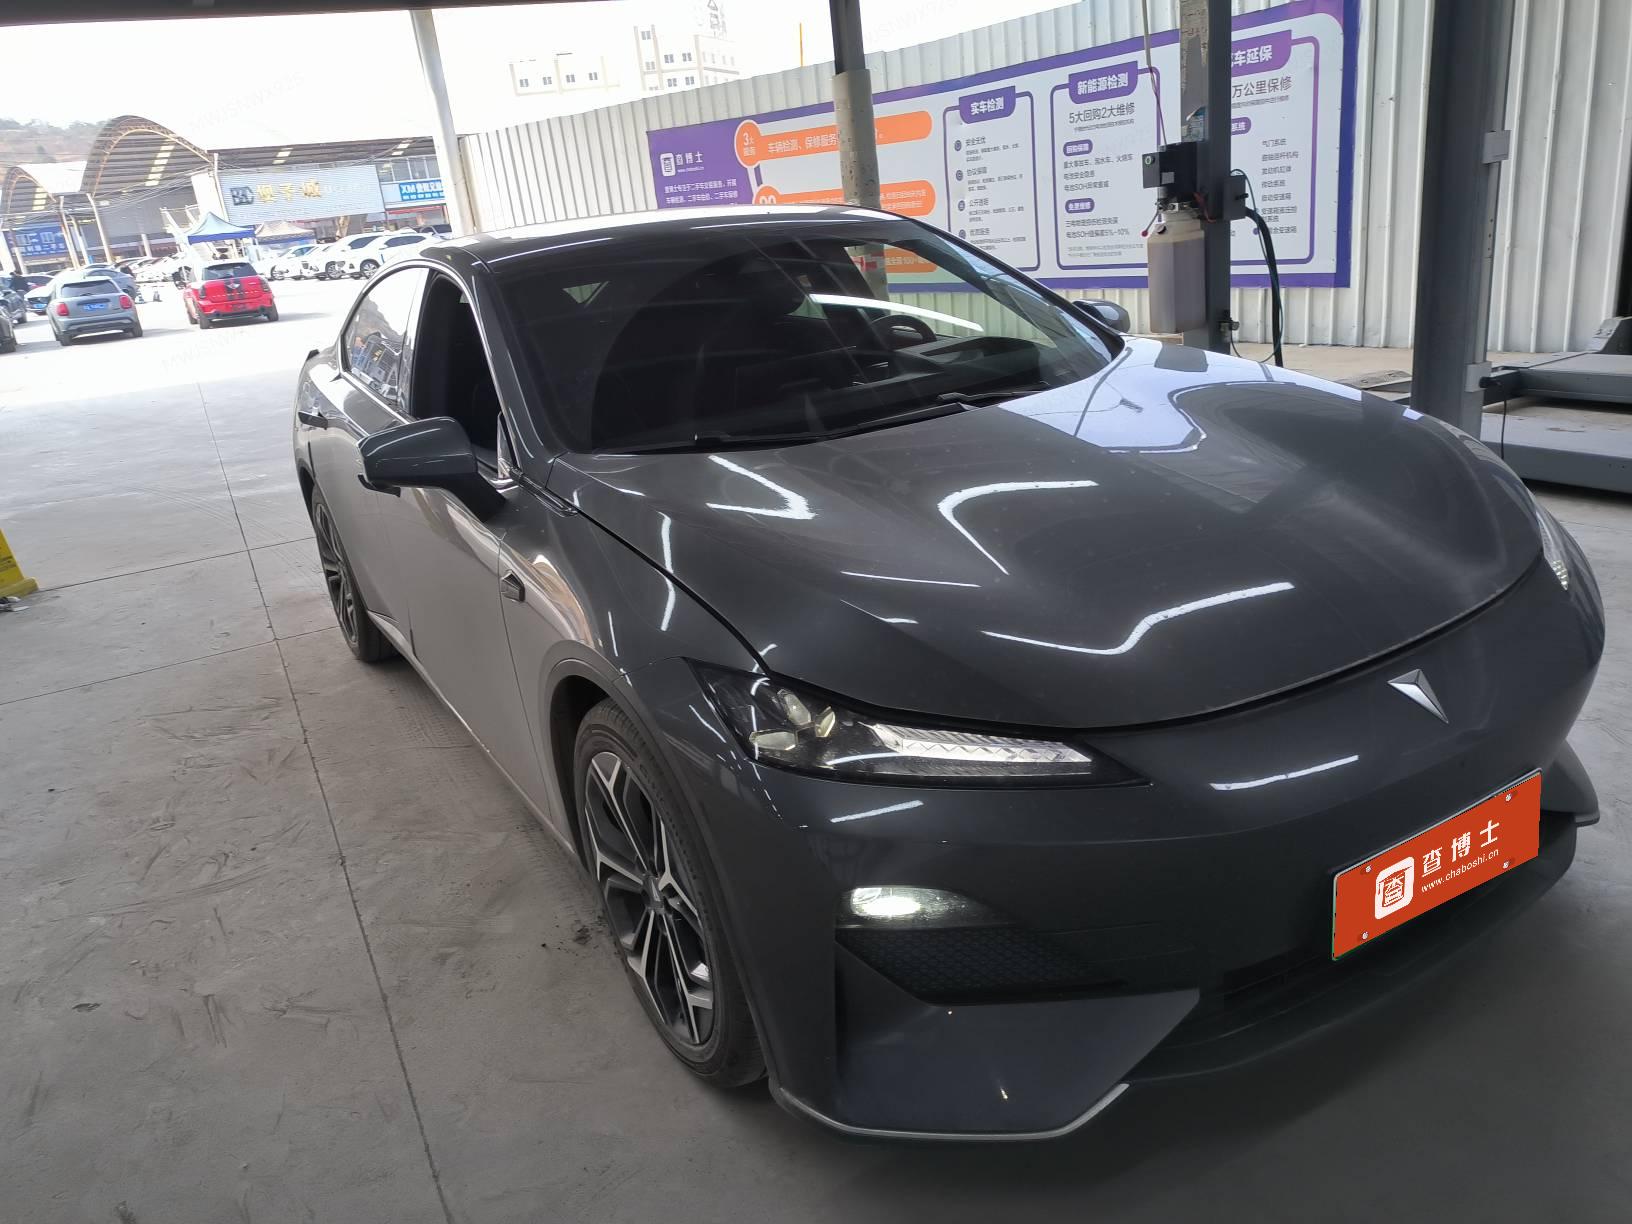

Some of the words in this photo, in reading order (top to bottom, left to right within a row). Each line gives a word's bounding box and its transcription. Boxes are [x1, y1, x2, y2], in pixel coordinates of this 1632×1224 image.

[1077, 72, 1129, 95] 新能源检测
[1232, 76, 1292, 99] 万公里保修
[1069, 102, 1136, 124] 5大回购2大维修
